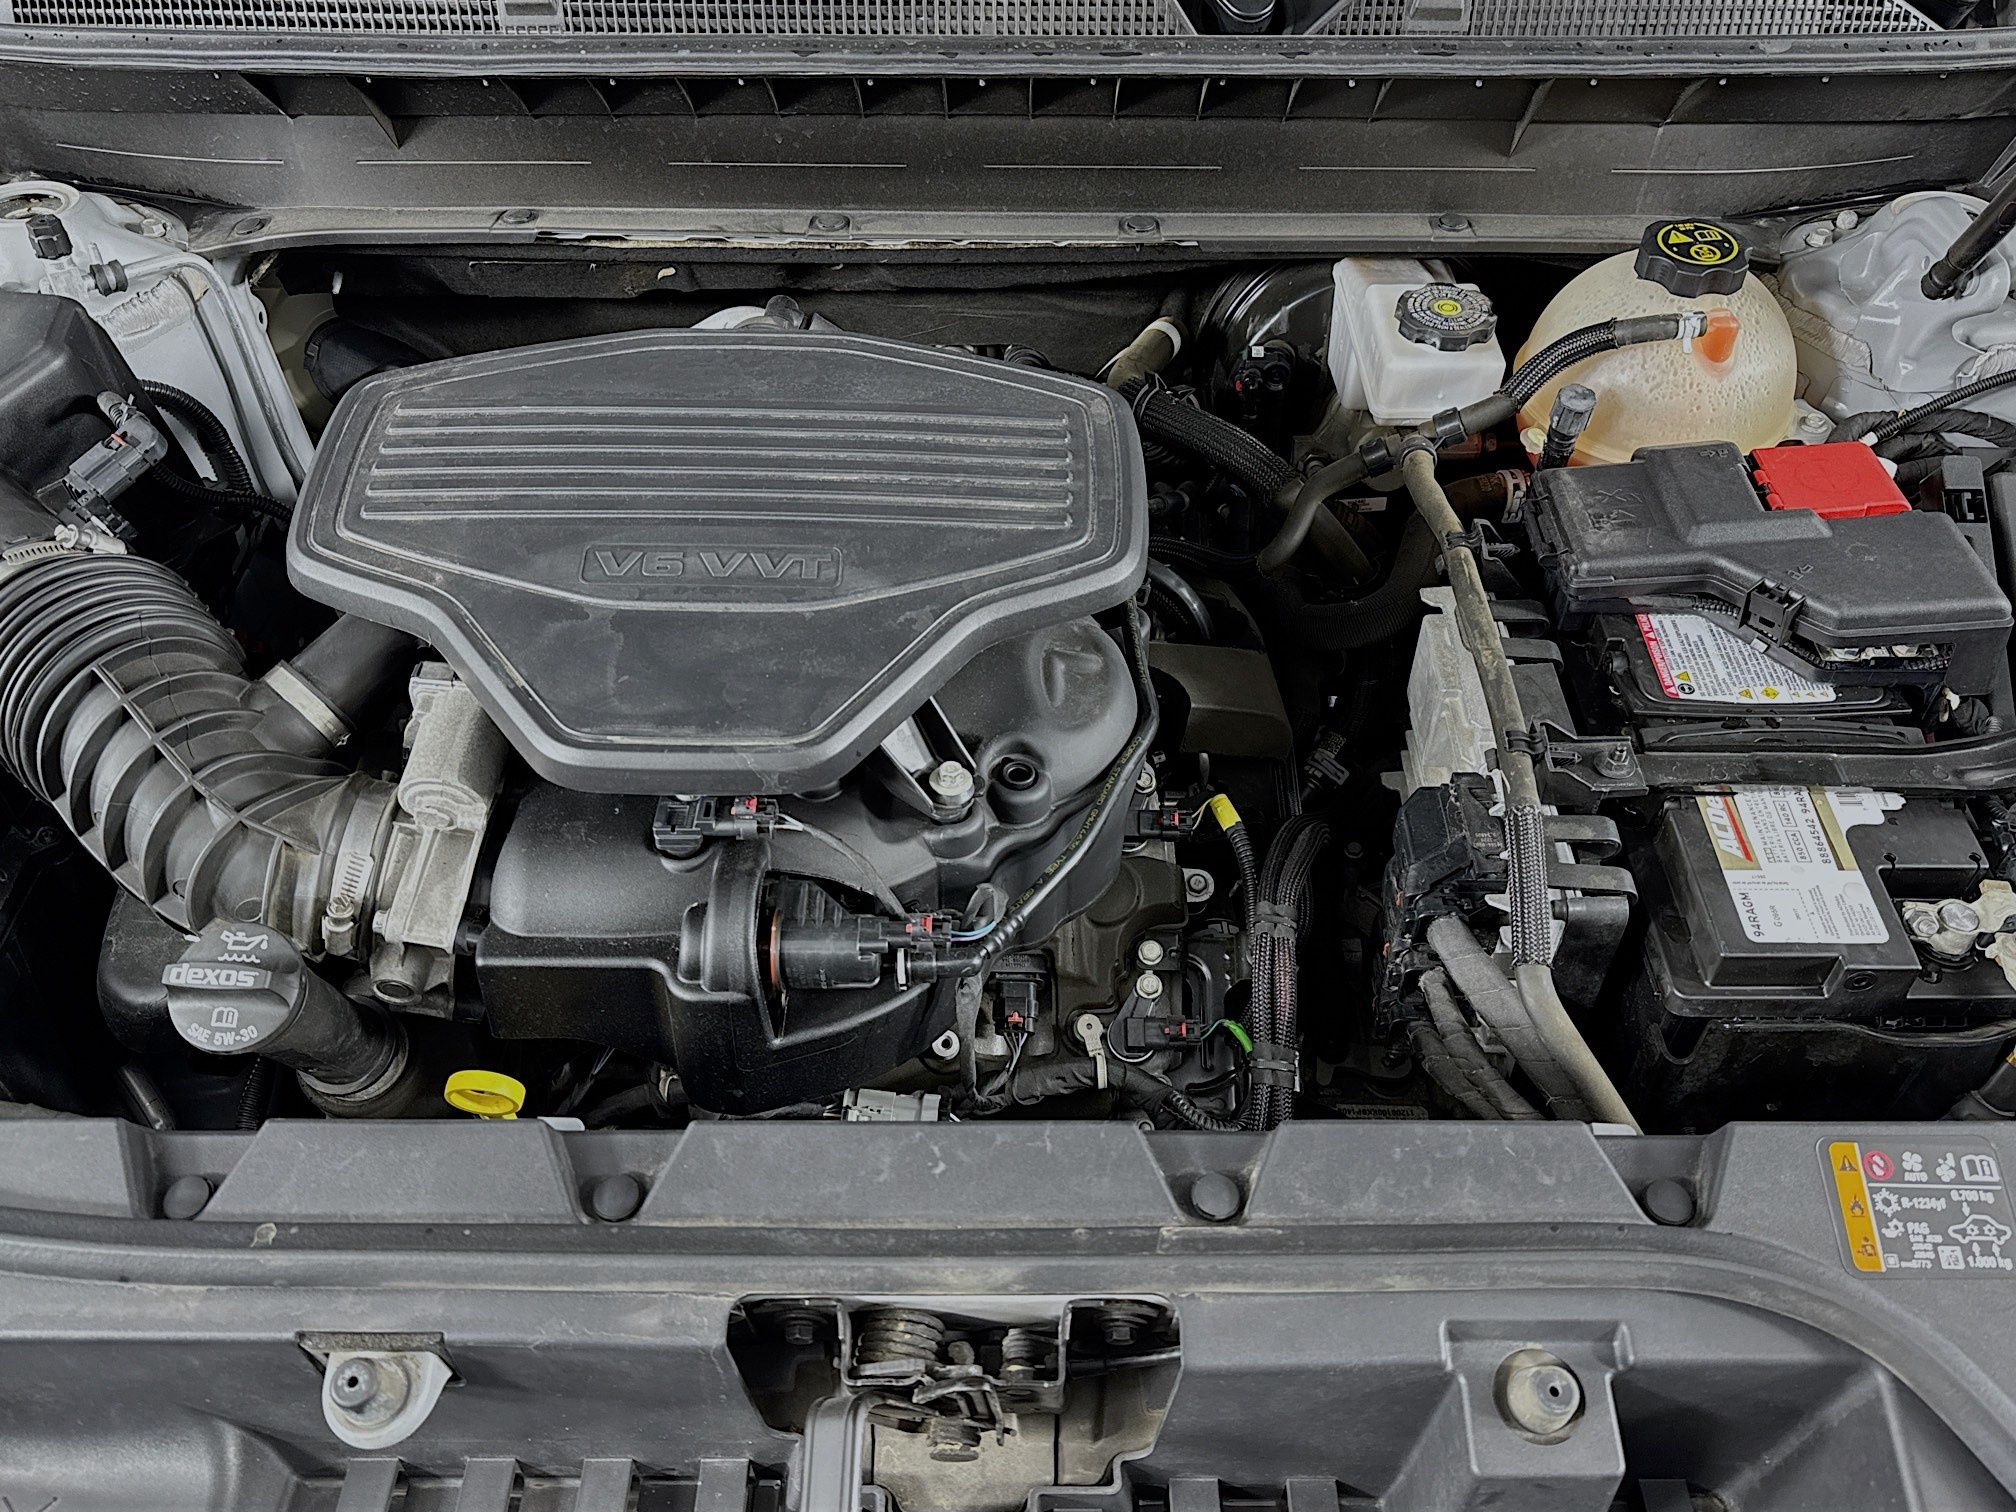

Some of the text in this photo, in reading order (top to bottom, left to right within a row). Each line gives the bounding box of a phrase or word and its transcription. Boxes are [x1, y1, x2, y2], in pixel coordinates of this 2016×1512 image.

[595, 551, 832, 579] V6 VVT
[1097, 767, 1121, 806] STANDARD
[1745, 800, 1767, 845] MAINTENANCE
[1782, 813, 1791, 824] 140
[1791, 833, 1806, 859] 850 CCA
[1805, 819, 1831, 863] 88864542
[1739, 892, 1764, 936] 94RAGM
[169, 963, 259, 987] dexos
[187, 1023, 258, 1046] SAE 5W-30
[1904, 1172, 1928, 1182] AUTO
[1907, 1222, 1930, 1235] PAG
